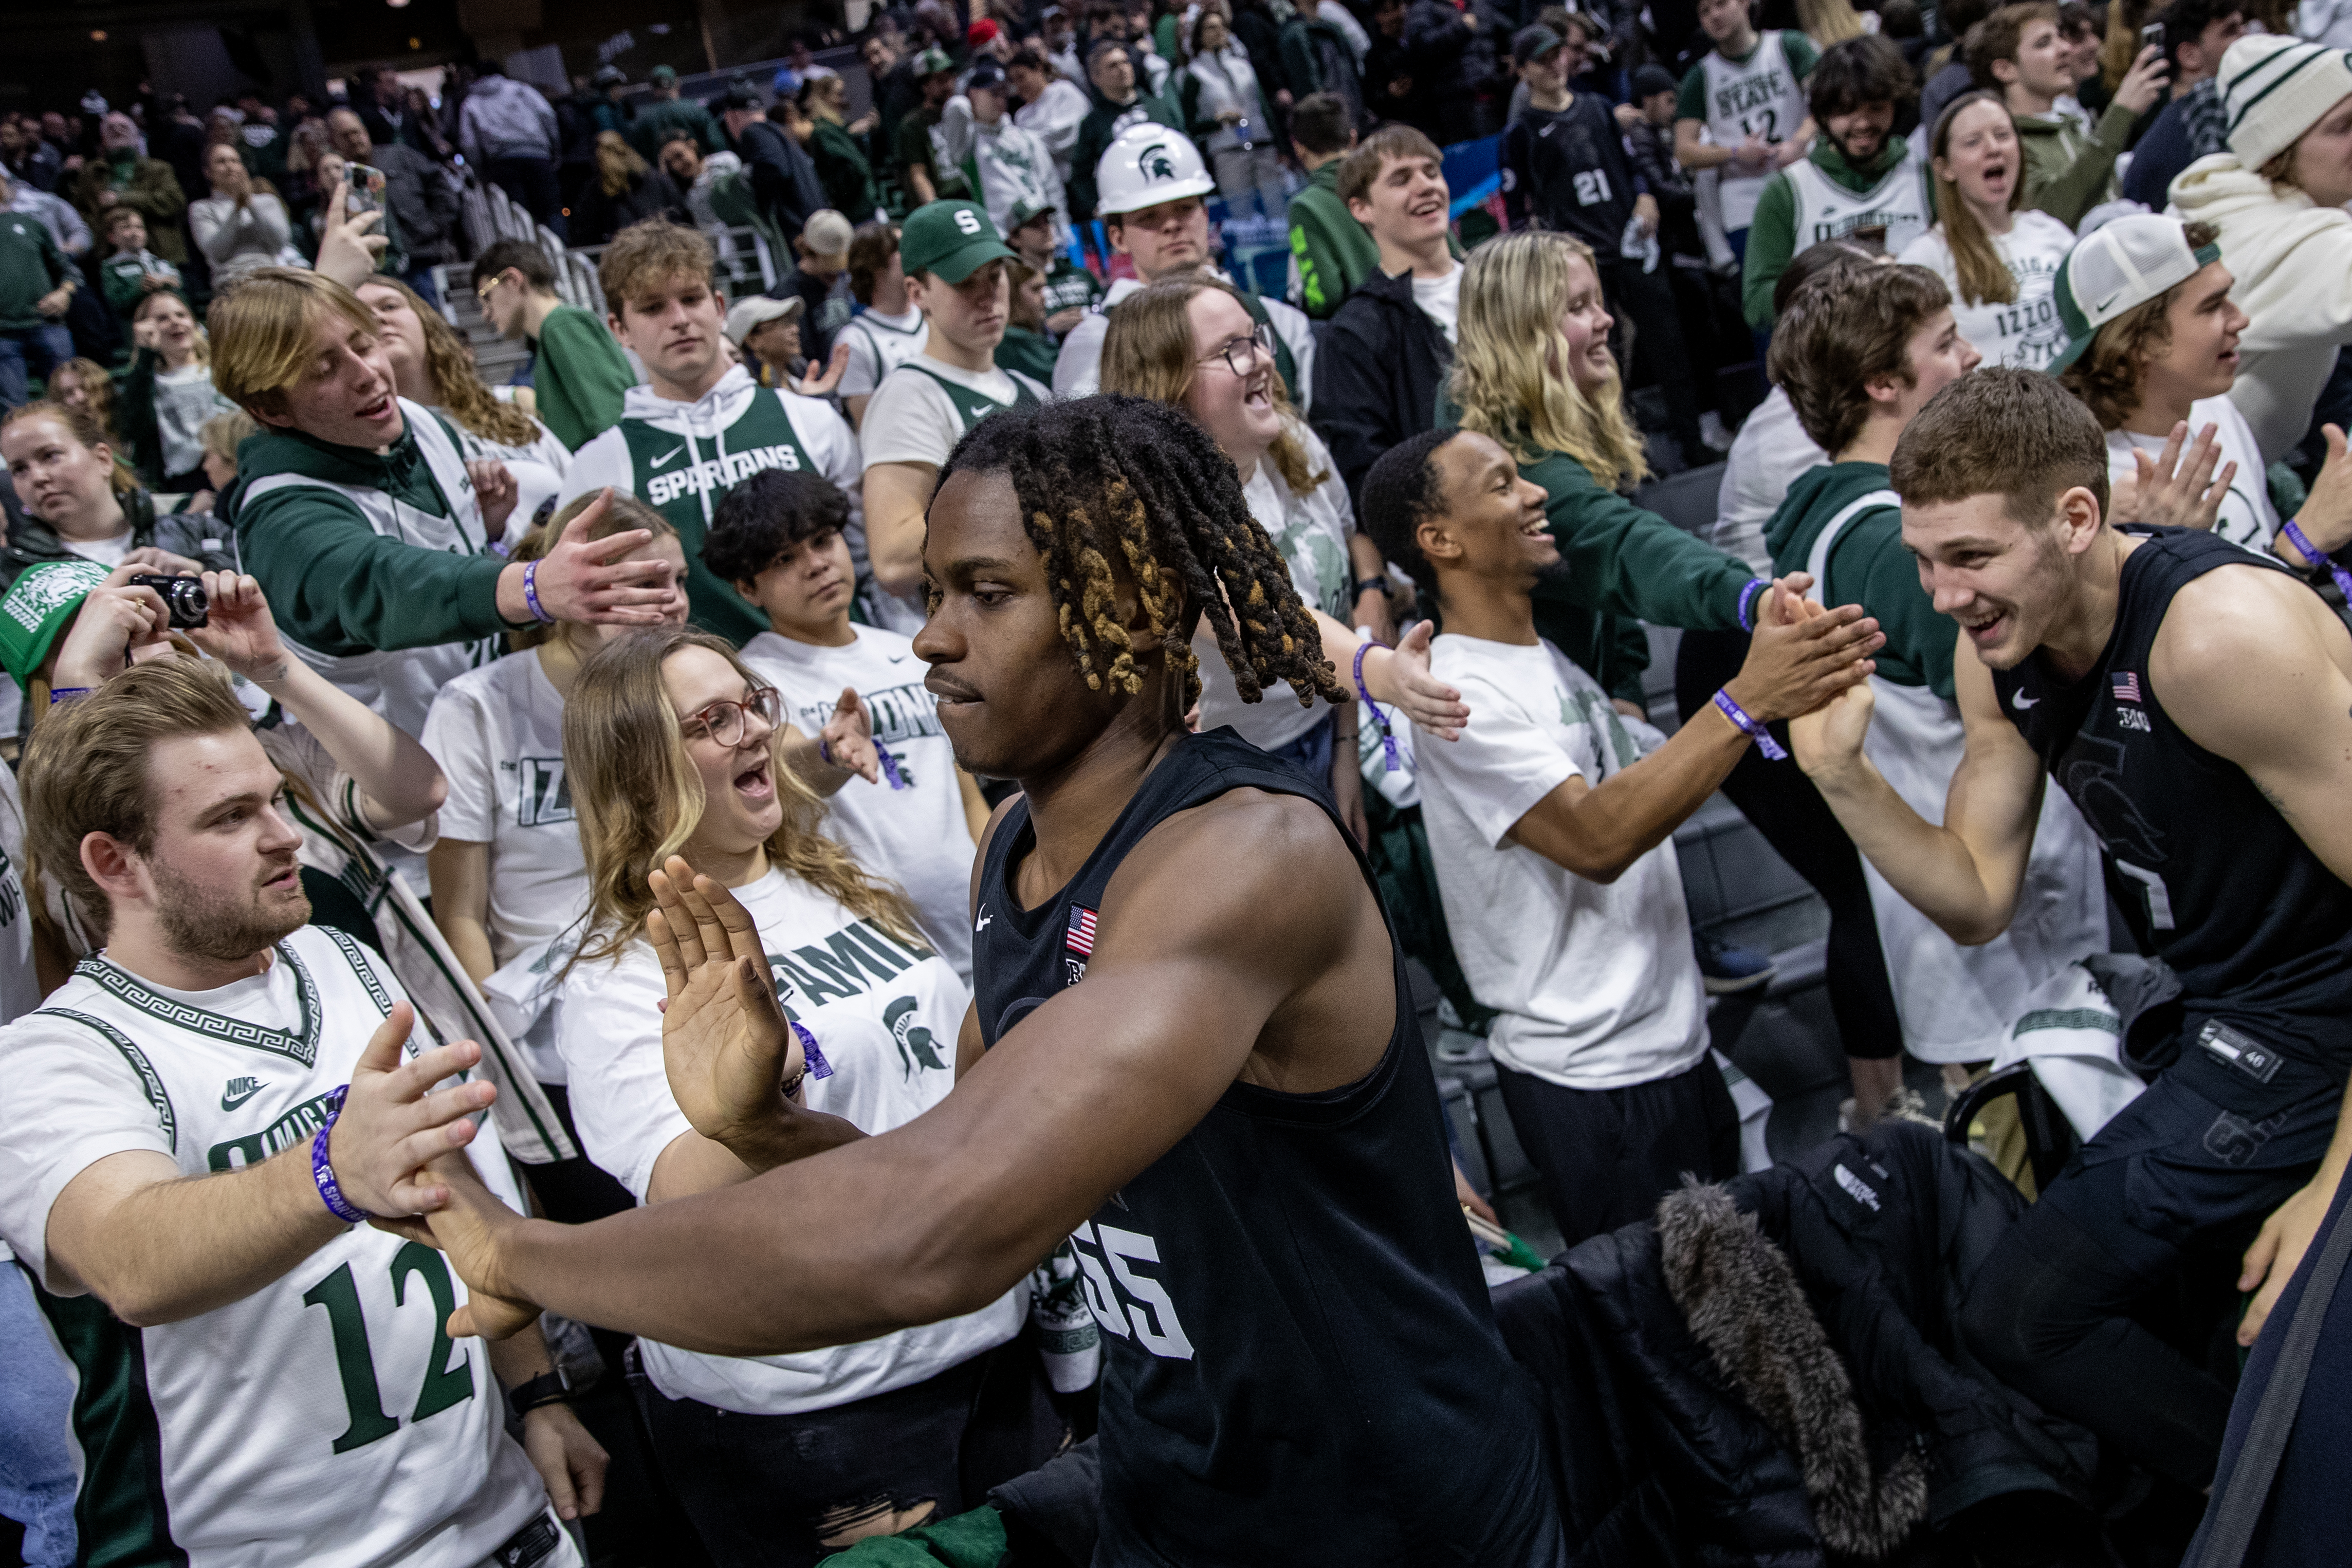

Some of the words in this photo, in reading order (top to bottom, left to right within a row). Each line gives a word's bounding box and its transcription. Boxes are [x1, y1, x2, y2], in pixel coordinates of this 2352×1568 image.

[1572, 168, 1612, 207] 21
[953, 209, 981, 235] S
[1996, 300, 2052, 337] IZZO
[647, 444, 801, 506] SPARTANS
[518, 758, 577, 827] IZ
[226, 1076, 259, 1097] NIKE
[1068, 1220, 1195, 1360] 55
[302, 1240, 476, 1455] 12
